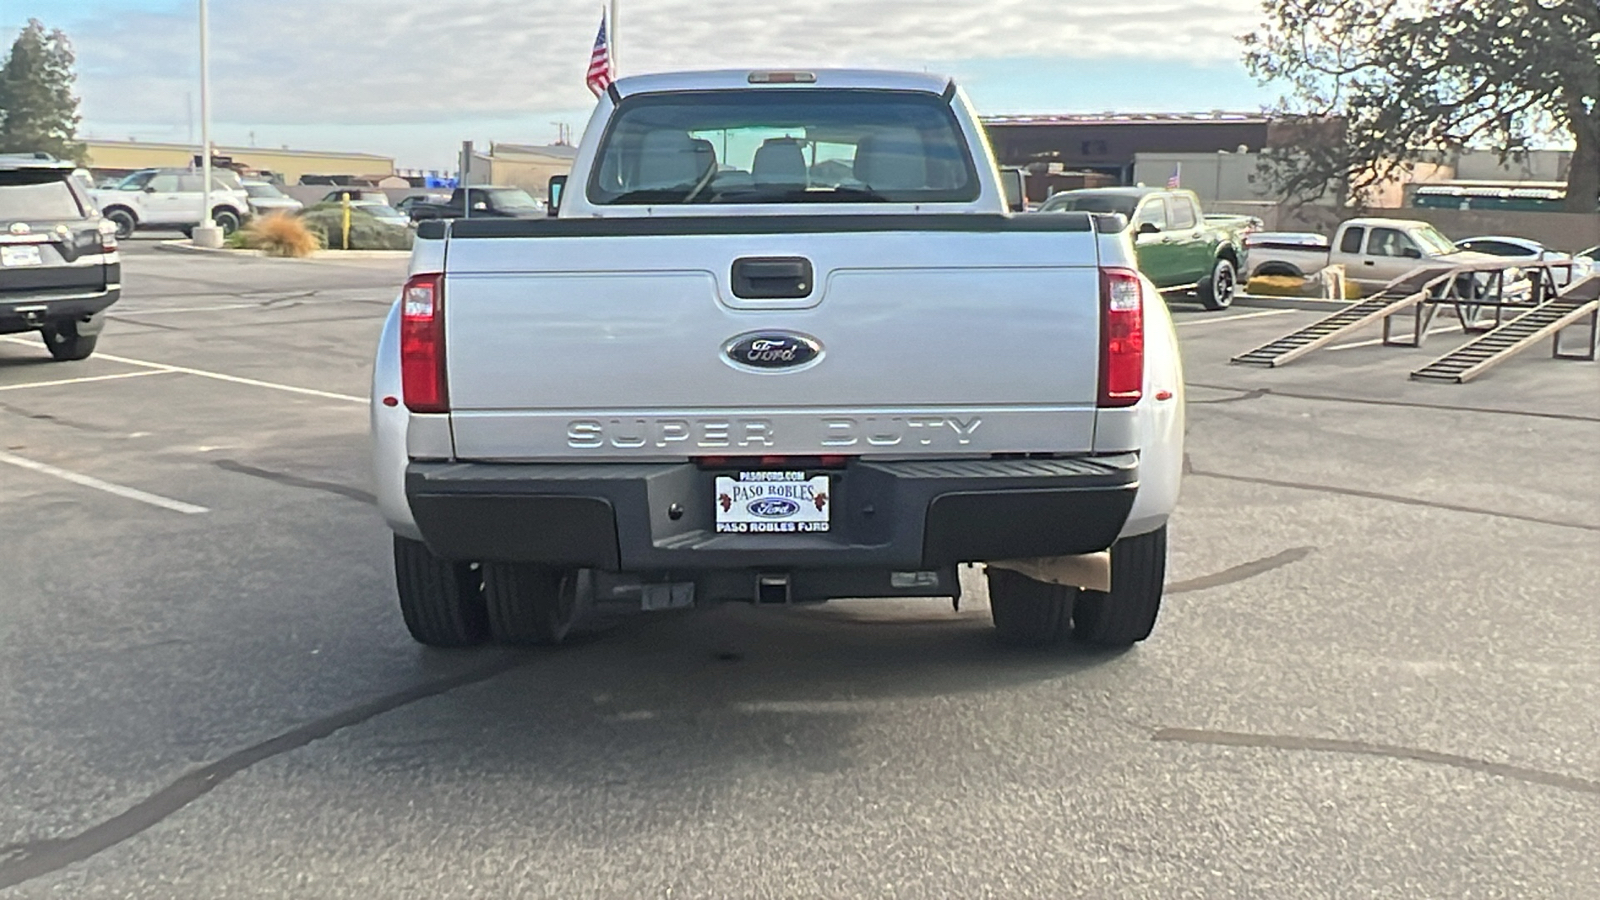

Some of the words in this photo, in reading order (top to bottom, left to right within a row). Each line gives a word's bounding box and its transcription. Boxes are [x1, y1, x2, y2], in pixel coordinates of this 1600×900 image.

[747, 339, 797, 361] Ford
[567, 418, 775, 448] SUPER
[820, 416, 983, 446] DUTY
[733, 486, 763, 502] PASO
[768, 484, 815, 501] ROBLES
[757, 501, 791, 516] Ford
[716, 523, 748, 533] PASO
[750, 523, 796, 533] ROBLES
[798, 522, 830, 532] FORD
